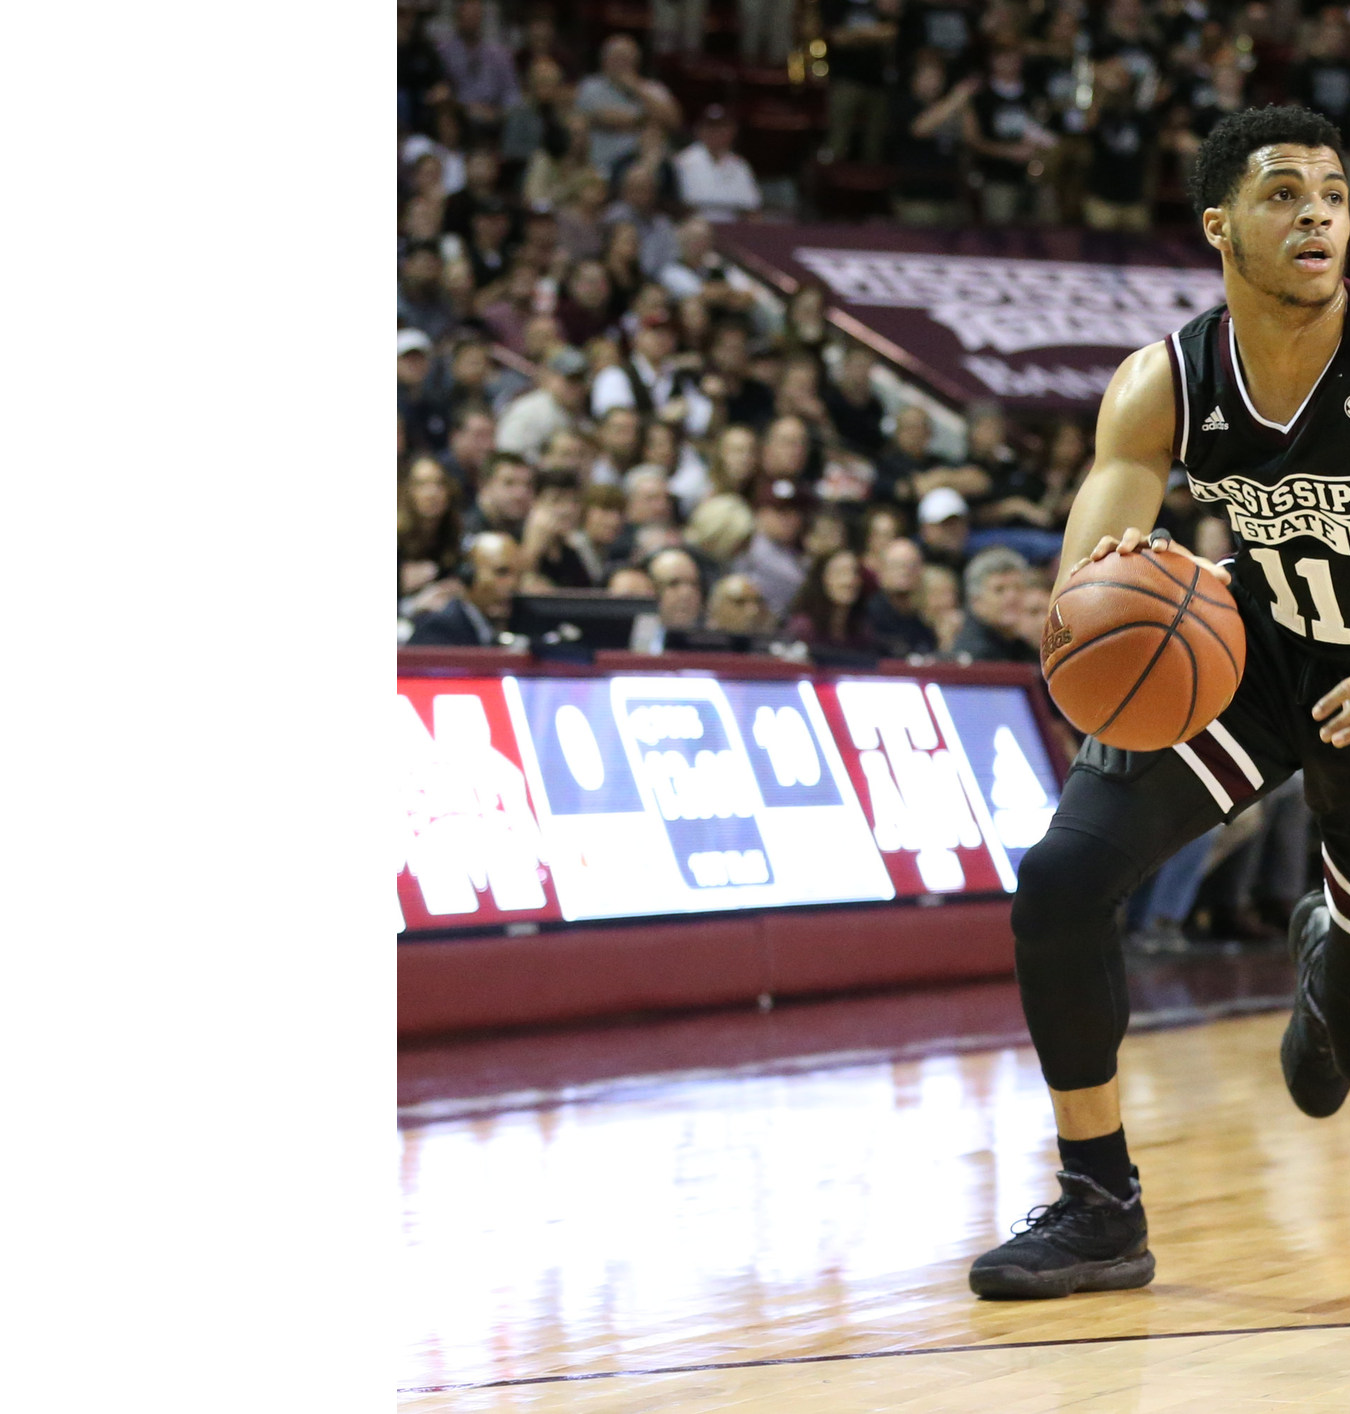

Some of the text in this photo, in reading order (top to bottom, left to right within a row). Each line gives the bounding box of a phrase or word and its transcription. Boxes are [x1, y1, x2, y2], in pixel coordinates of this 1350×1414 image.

[1201, 422, 1229, 431] adidas
[1245, 514, 1338, 547] STATE
[555, 705, 605, 791] 0
